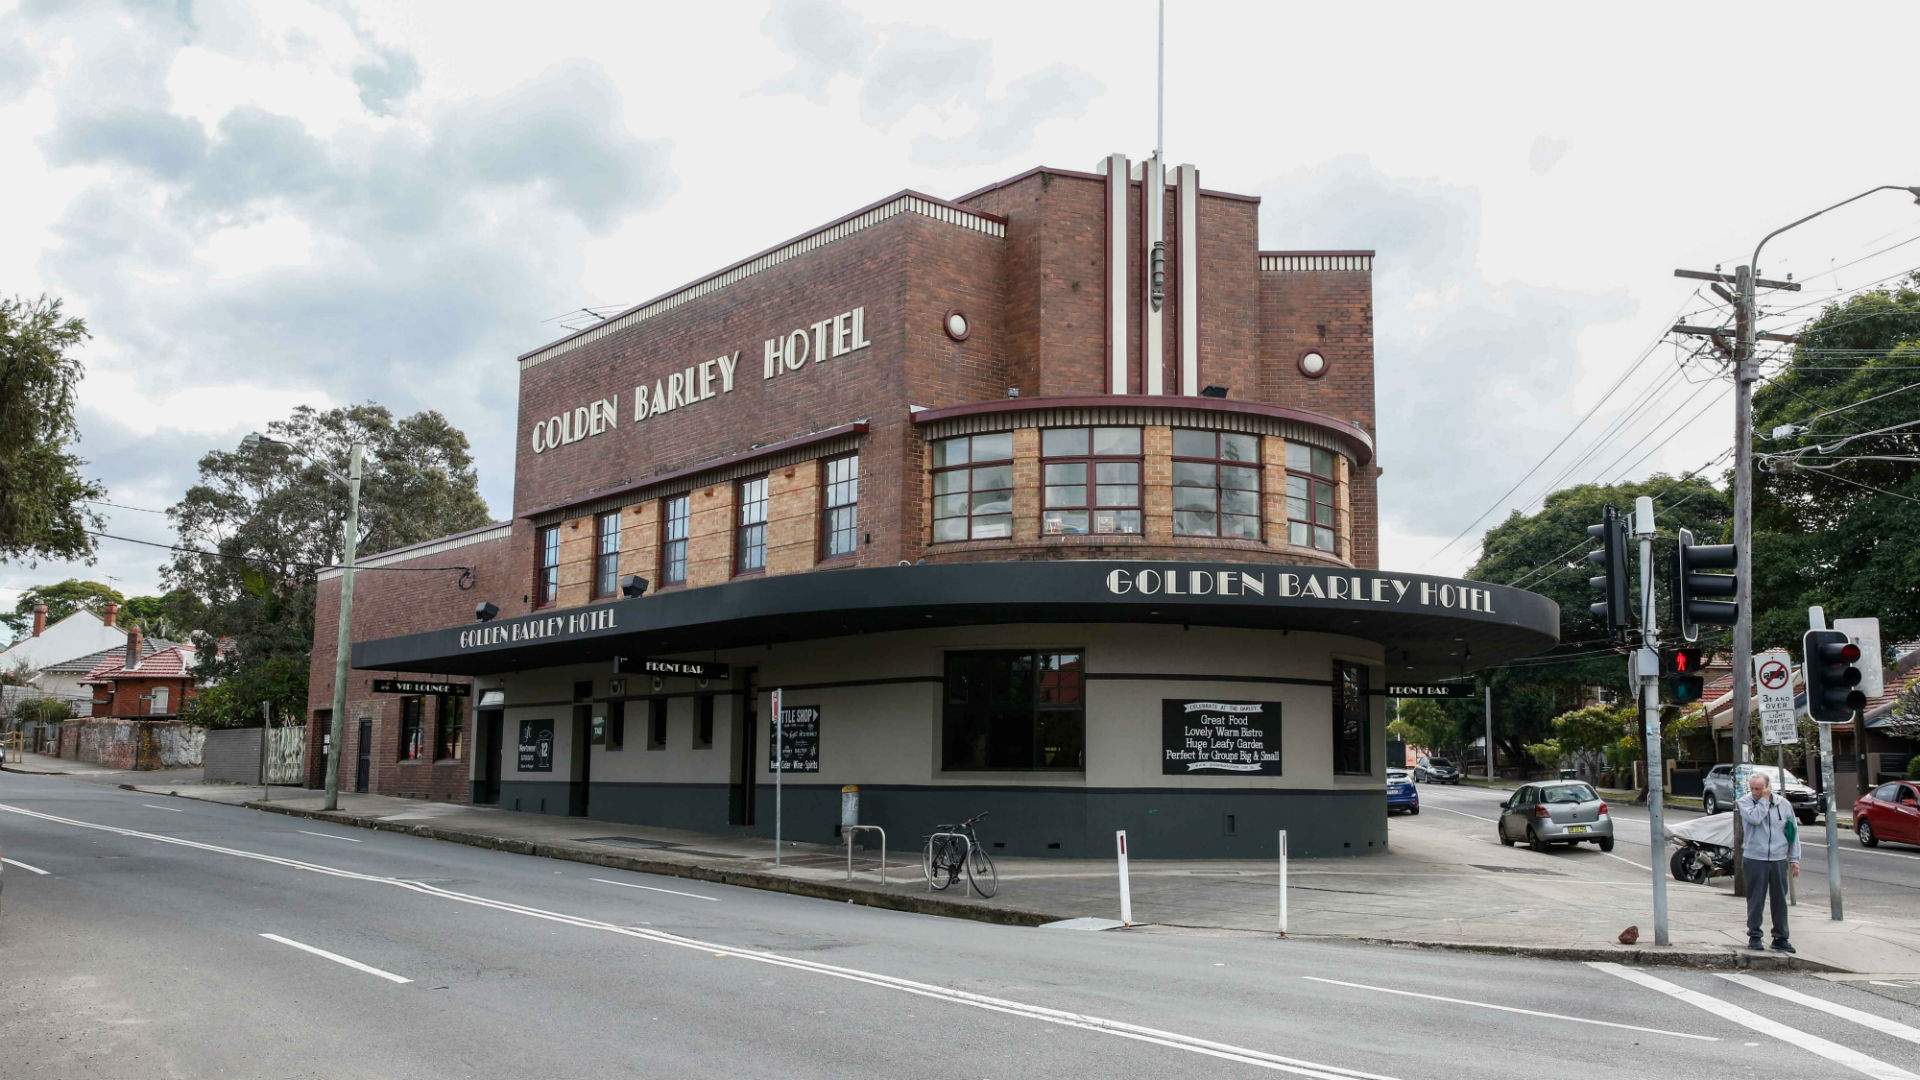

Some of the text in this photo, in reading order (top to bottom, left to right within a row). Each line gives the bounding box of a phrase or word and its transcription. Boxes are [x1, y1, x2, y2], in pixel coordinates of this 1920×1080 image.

[634, 351, 741, 422] BARLEY
[763, 306, 871, 380] HOTEL
[1106, 569, 1496, 614] GOLDEN BARLEY HOTEL
[460, 608, 618, 649] GOLDEN BARLEY HOTEL
[646, 661, 704, 674] FRONT BAR
[415, 684, 450, 693] LOUNGE
[1389, 686, 1449, 695] FRONT BAR
[796, 708, 813, 723] SHOP
[1200, 714, 1249, 725] Great Food
[1184, 725, 1263, 738] Lovely Warm Bistro
[1186, 738, 1264, 750] Huge Leafy Garden
[1165, 749, 1280, 763] Perfect for Groups Big & Small
[793, 760, 803, 769] Wine
